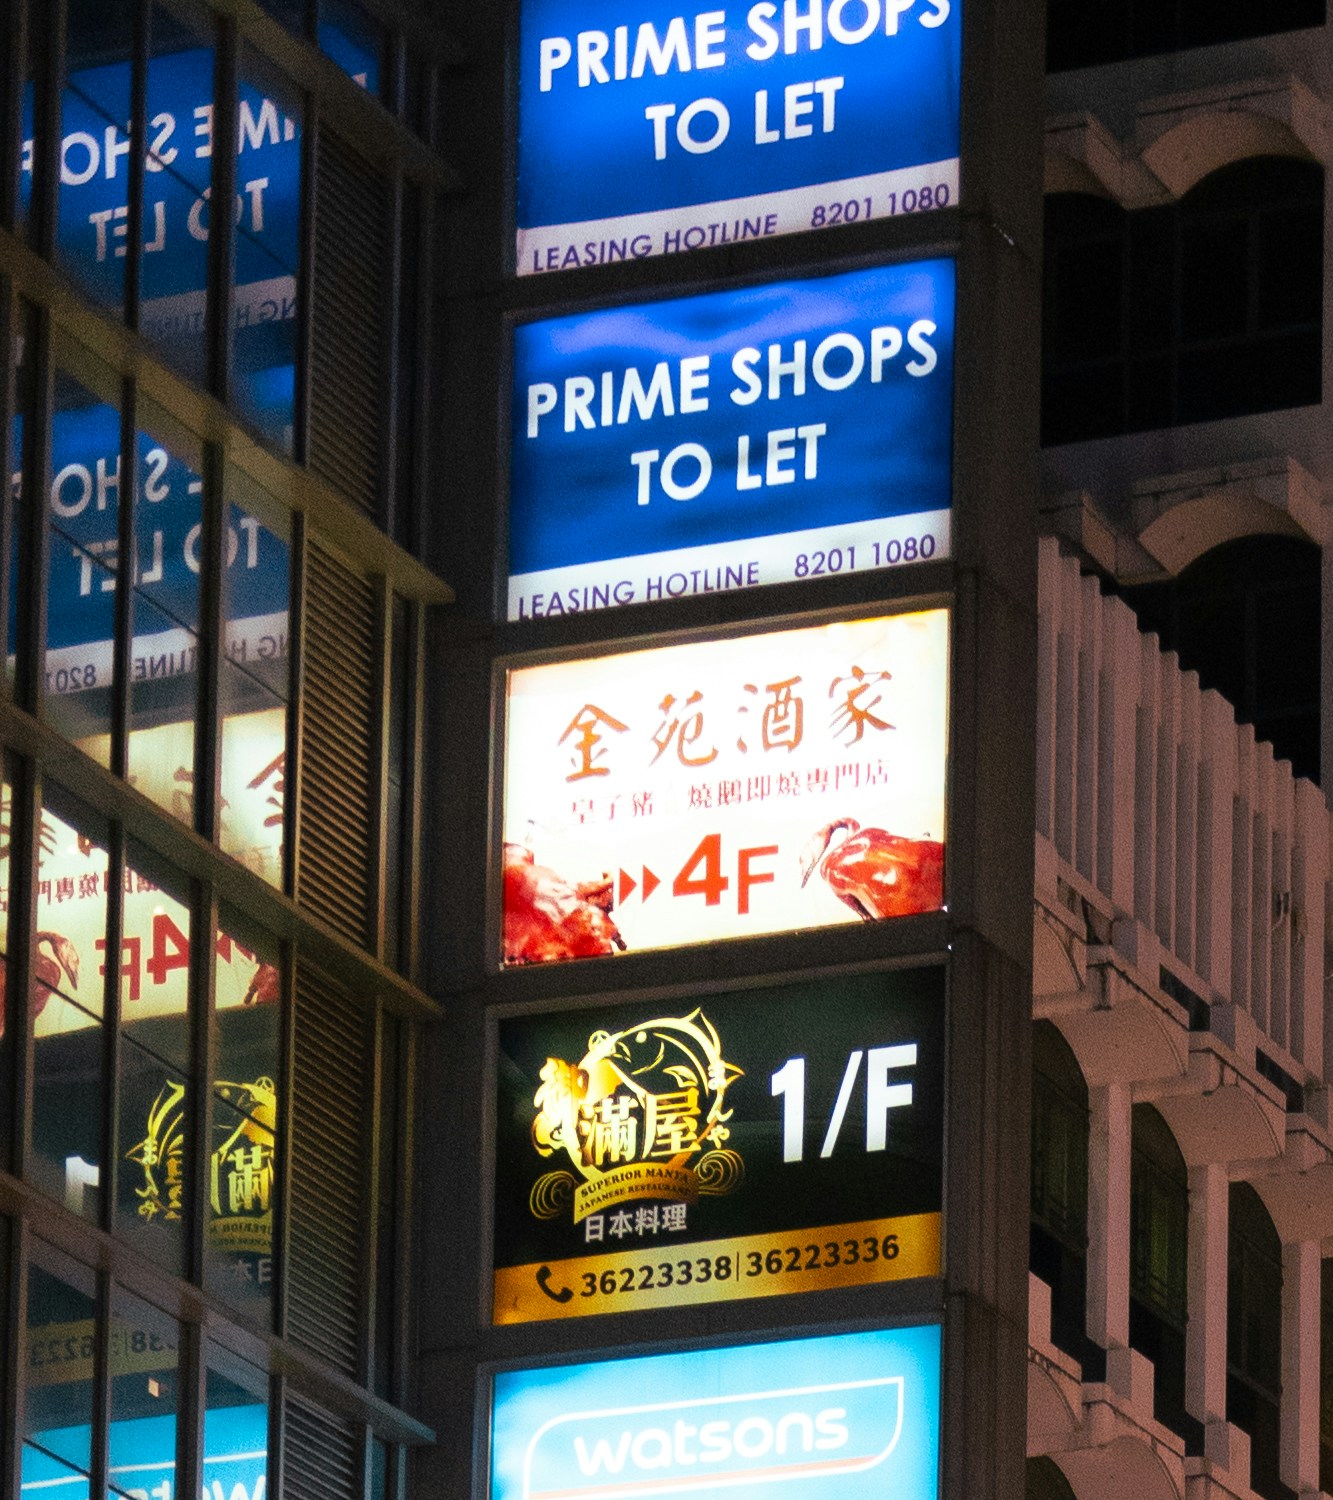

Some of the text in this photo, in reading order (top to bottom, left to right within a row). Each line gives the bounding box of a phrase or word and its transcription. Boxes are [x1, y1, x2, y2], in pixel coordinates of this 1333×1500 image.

[539, 0, 953, 93] PRIME SHOPS
[645, 76, 847, 162] TO LET
[532, 183, 952, 274] LEASING HOTLINE 8201 1080
[526, 318, 939, 440] PRIME SHOPS
[630, 423, 828, 507] TO LET
[518, 532, 937, 622] LEASING HOTLINE 8201 1080
[557, 663, 897, 785] 金苑酒家
[672, 831, 781, 917] 4F
[770, 1043, 919, 1165] 1/F
[578, 1167, 642, 1199] SUPERIOR
[582, 1203, 688, 1243] 日本料理
[580, 1231, 901, 1300] 36223338 36223336
[574, 1404, 849, 1478] watsons
